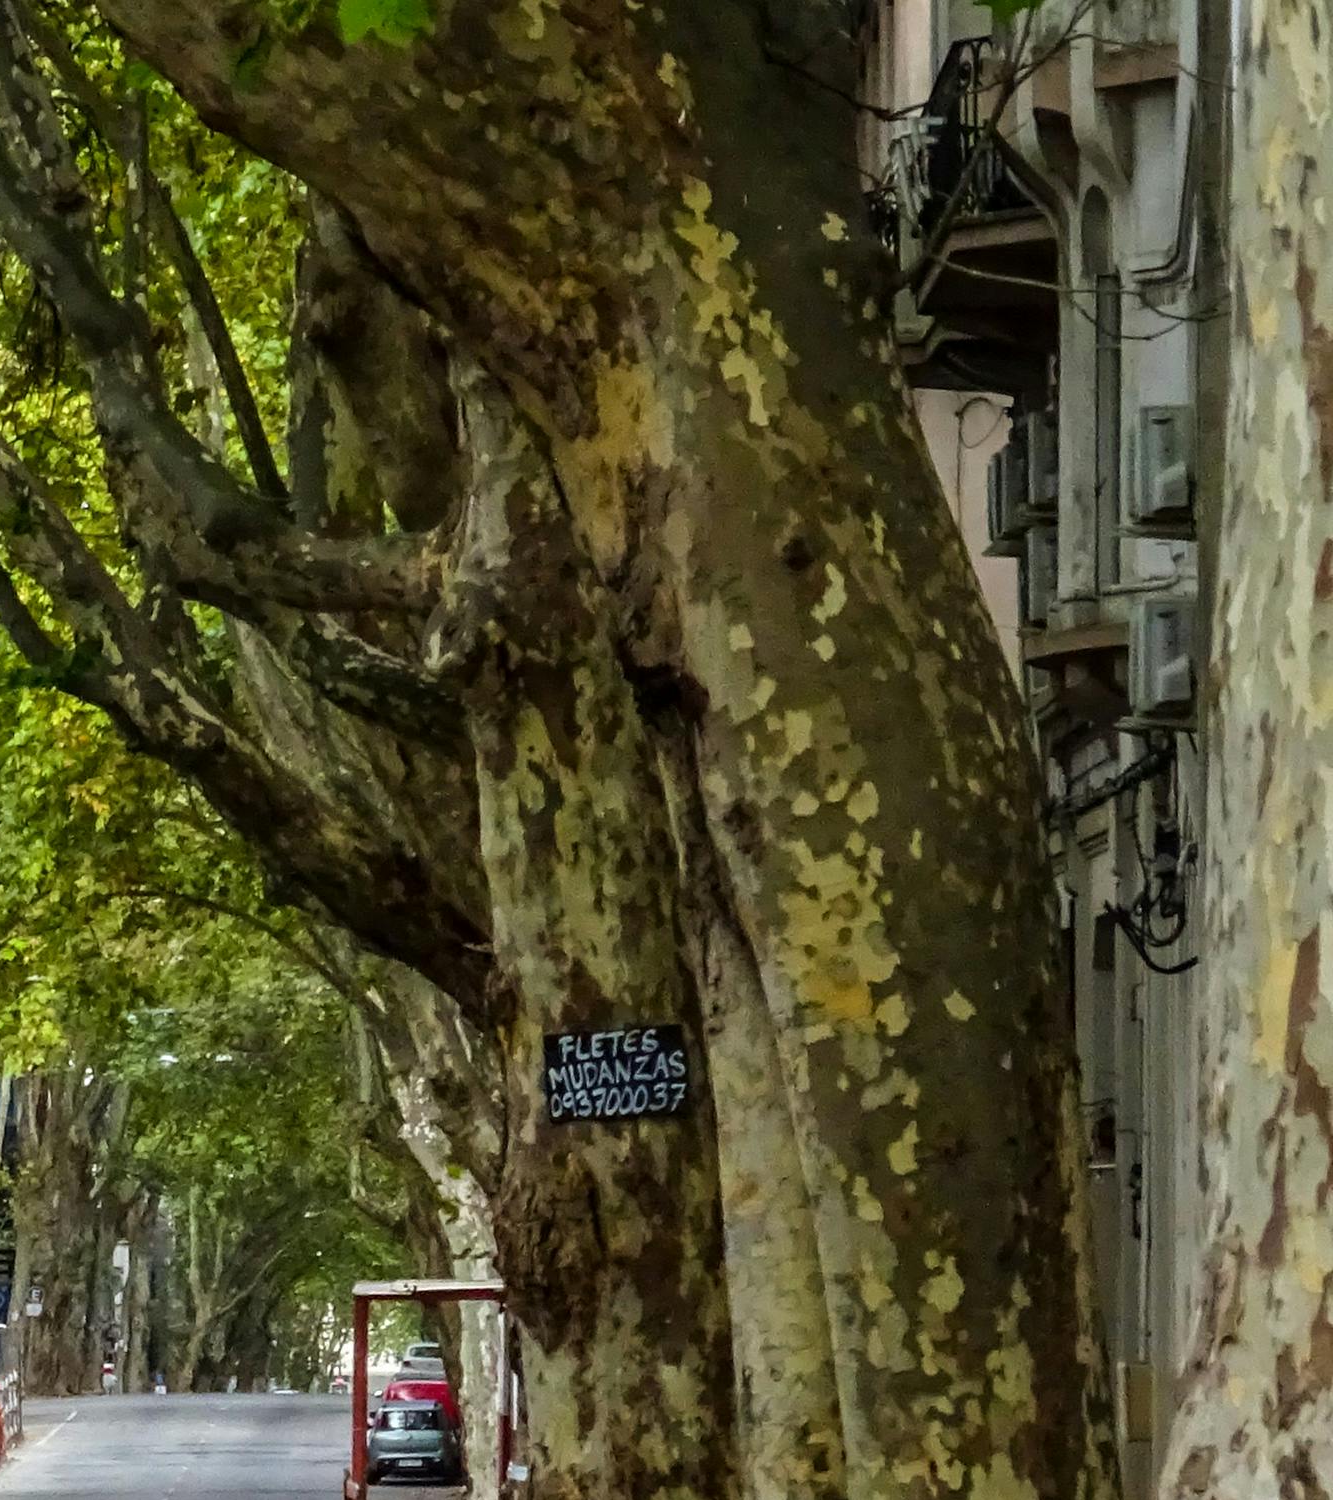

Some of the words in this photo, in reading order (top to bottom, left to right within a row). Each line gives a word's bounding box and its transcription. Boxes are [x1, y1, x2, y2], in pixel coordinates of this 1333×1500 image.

[558, 1029, 659, 1062] FLETES
[548, 1050, 686, 1091] MUDANZAS
[32, 1289, 41, 1298] E
